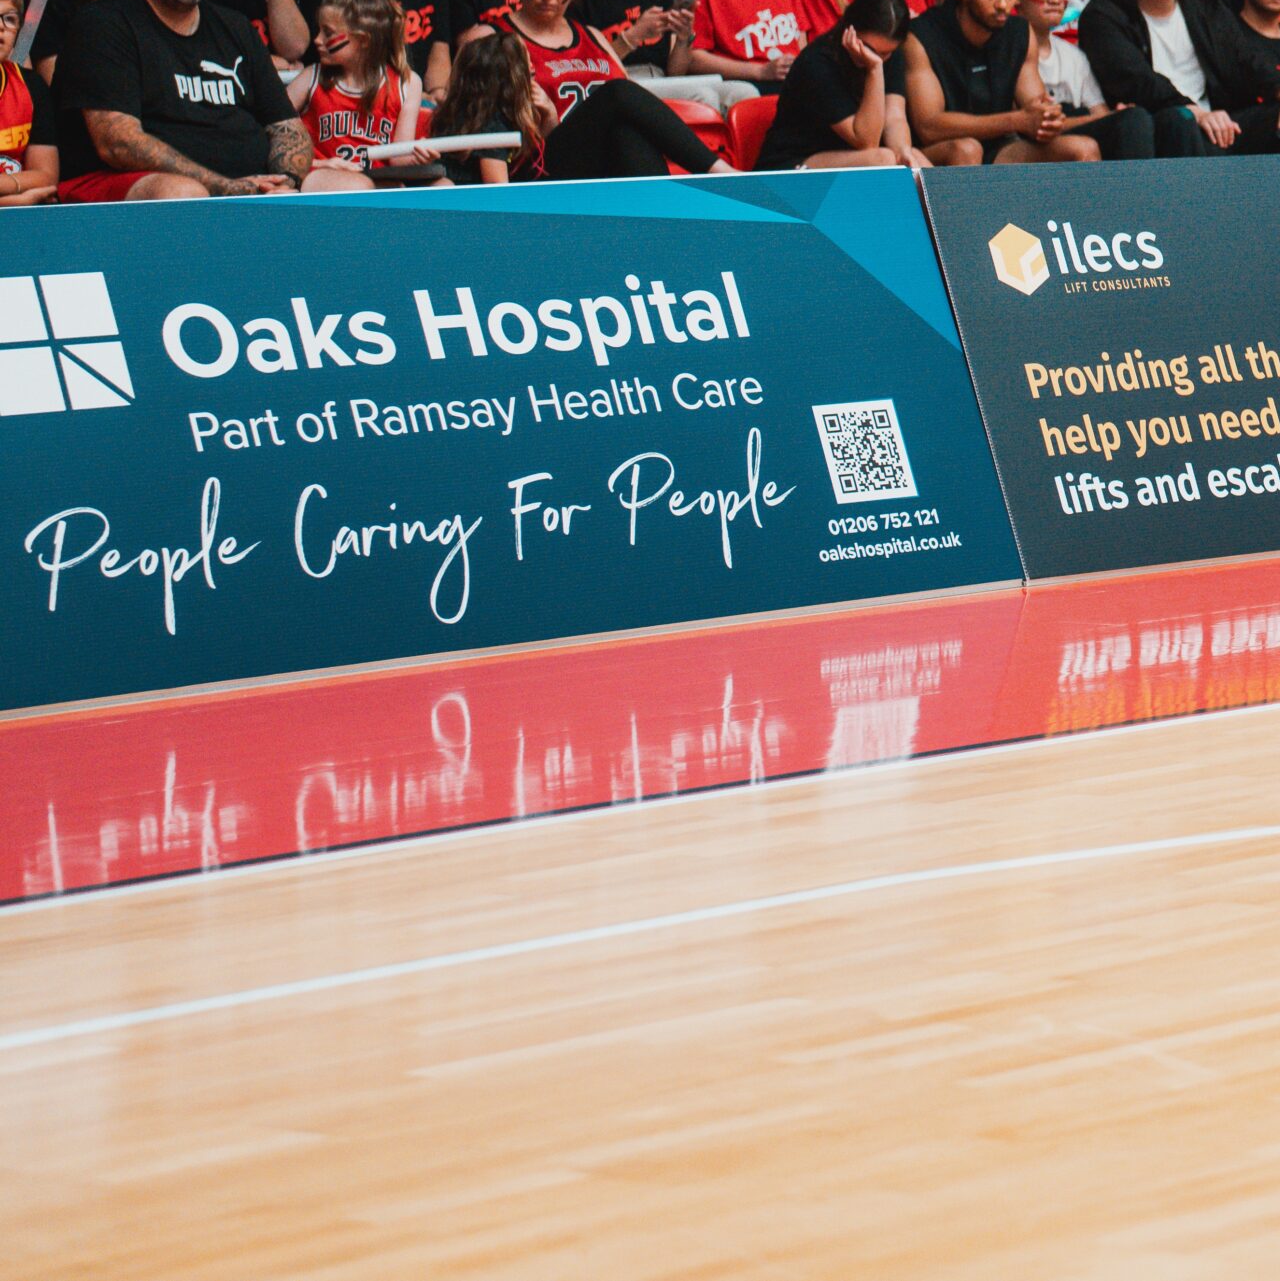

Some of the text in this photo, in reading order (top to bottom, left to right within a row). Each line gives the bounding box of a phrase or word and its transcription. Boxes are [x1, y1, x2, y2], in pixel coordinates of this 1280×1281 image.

[174, 73, 236, 106] PUMA
[558, 80, 606, 123] 2
[319, 110, 394, 145] BULLS
[1047, 220, 1164, 275] ilecs
[1064, 276, 1171, 294] LIFT CONSULTANTS
[162, 271, 751, 379] Oaks Hospital
[1024, 348, 1195, 399] Providing
[1198, 344, 1243, 385] all
[188, 372, 764, 452] Part of Ramsay Health Care
[1039, 414, 1121, 461] help
[1127, 413, 1193, 458] you
[1054, 471, 1130, 515] lifts
[1135, 462, 1201, 507] and
[24, 427, 797, 635] People Caring For People
[828, 508, 940, 536] 01206 752 121
[819, 531, 962, 562] oakshospital.co.uk
